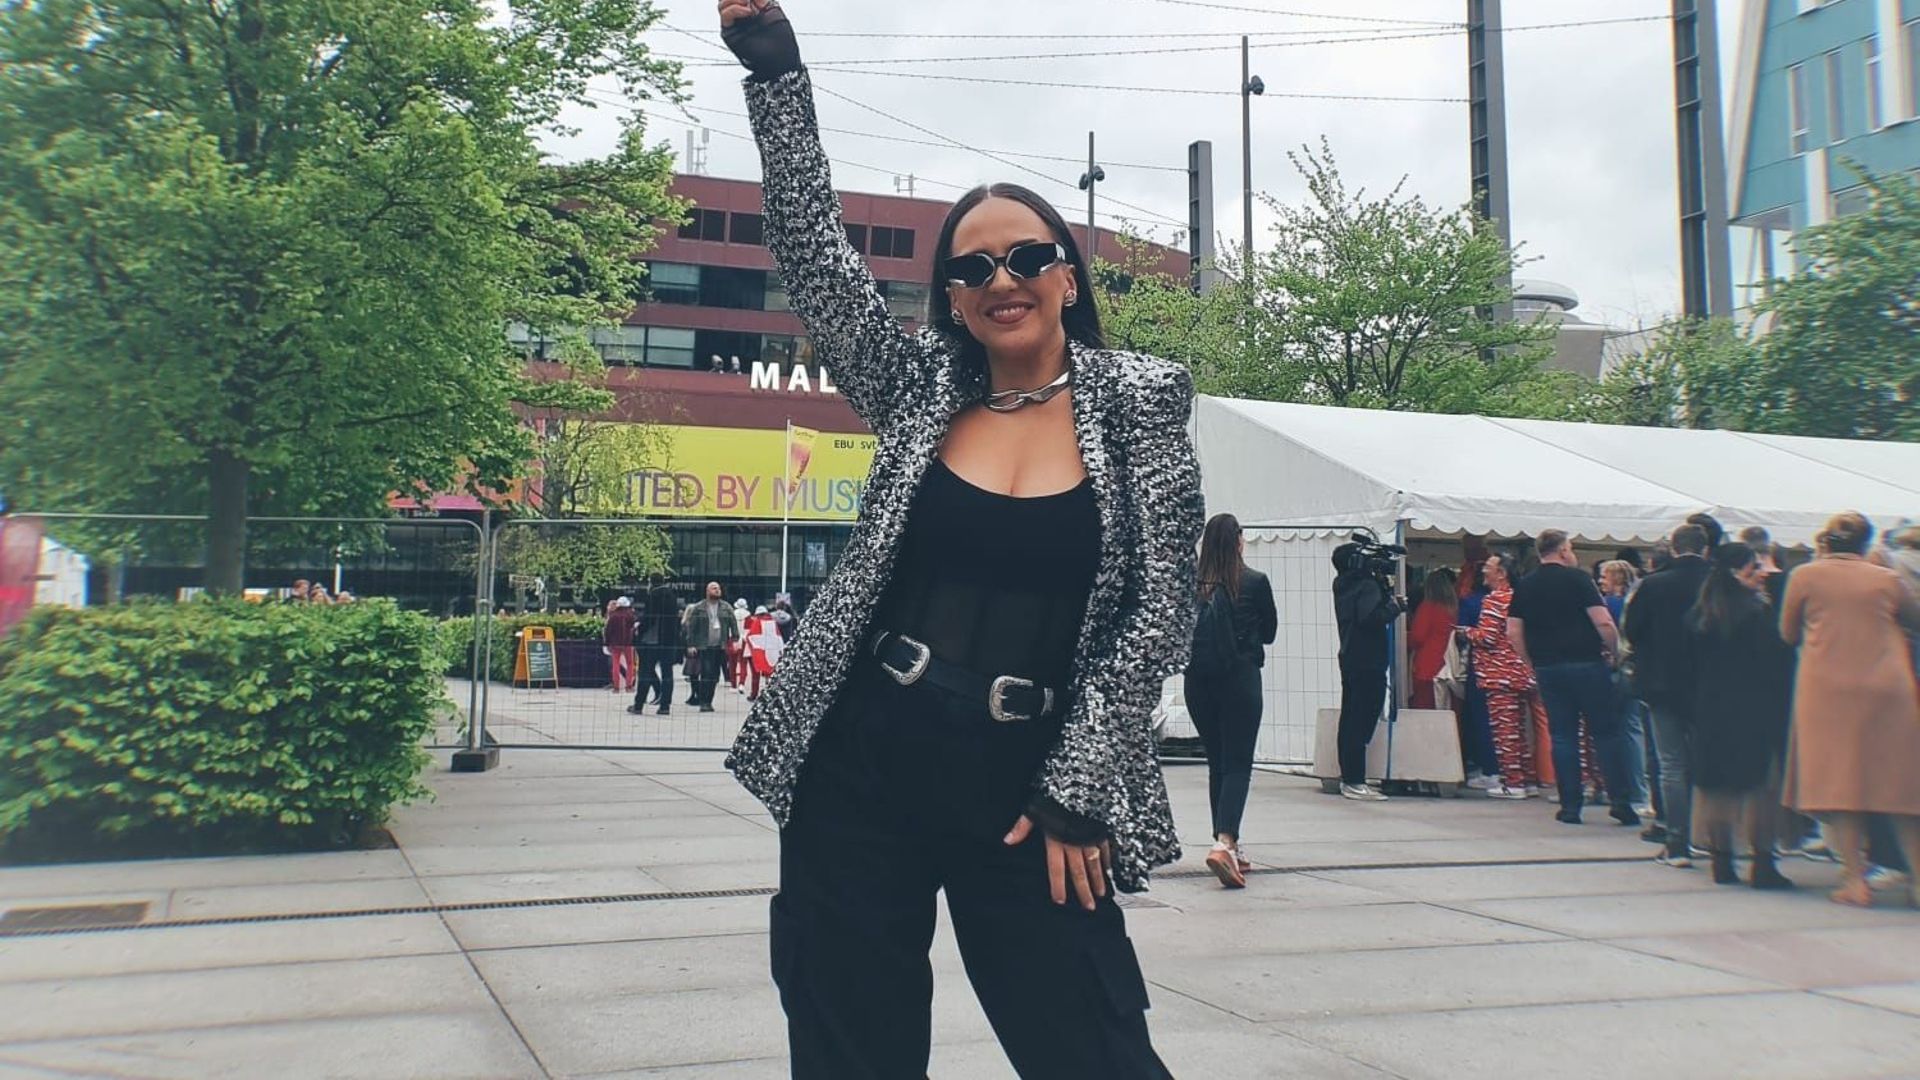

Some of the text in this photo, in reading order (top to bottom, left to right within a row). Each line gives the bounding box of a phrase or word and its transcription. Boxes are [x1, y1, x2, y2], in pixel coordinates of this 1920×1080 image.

[750, 361, 837, 394] MAL
[834, 440, 854, 449] EBU
[717, 474, 760, 510] BY
